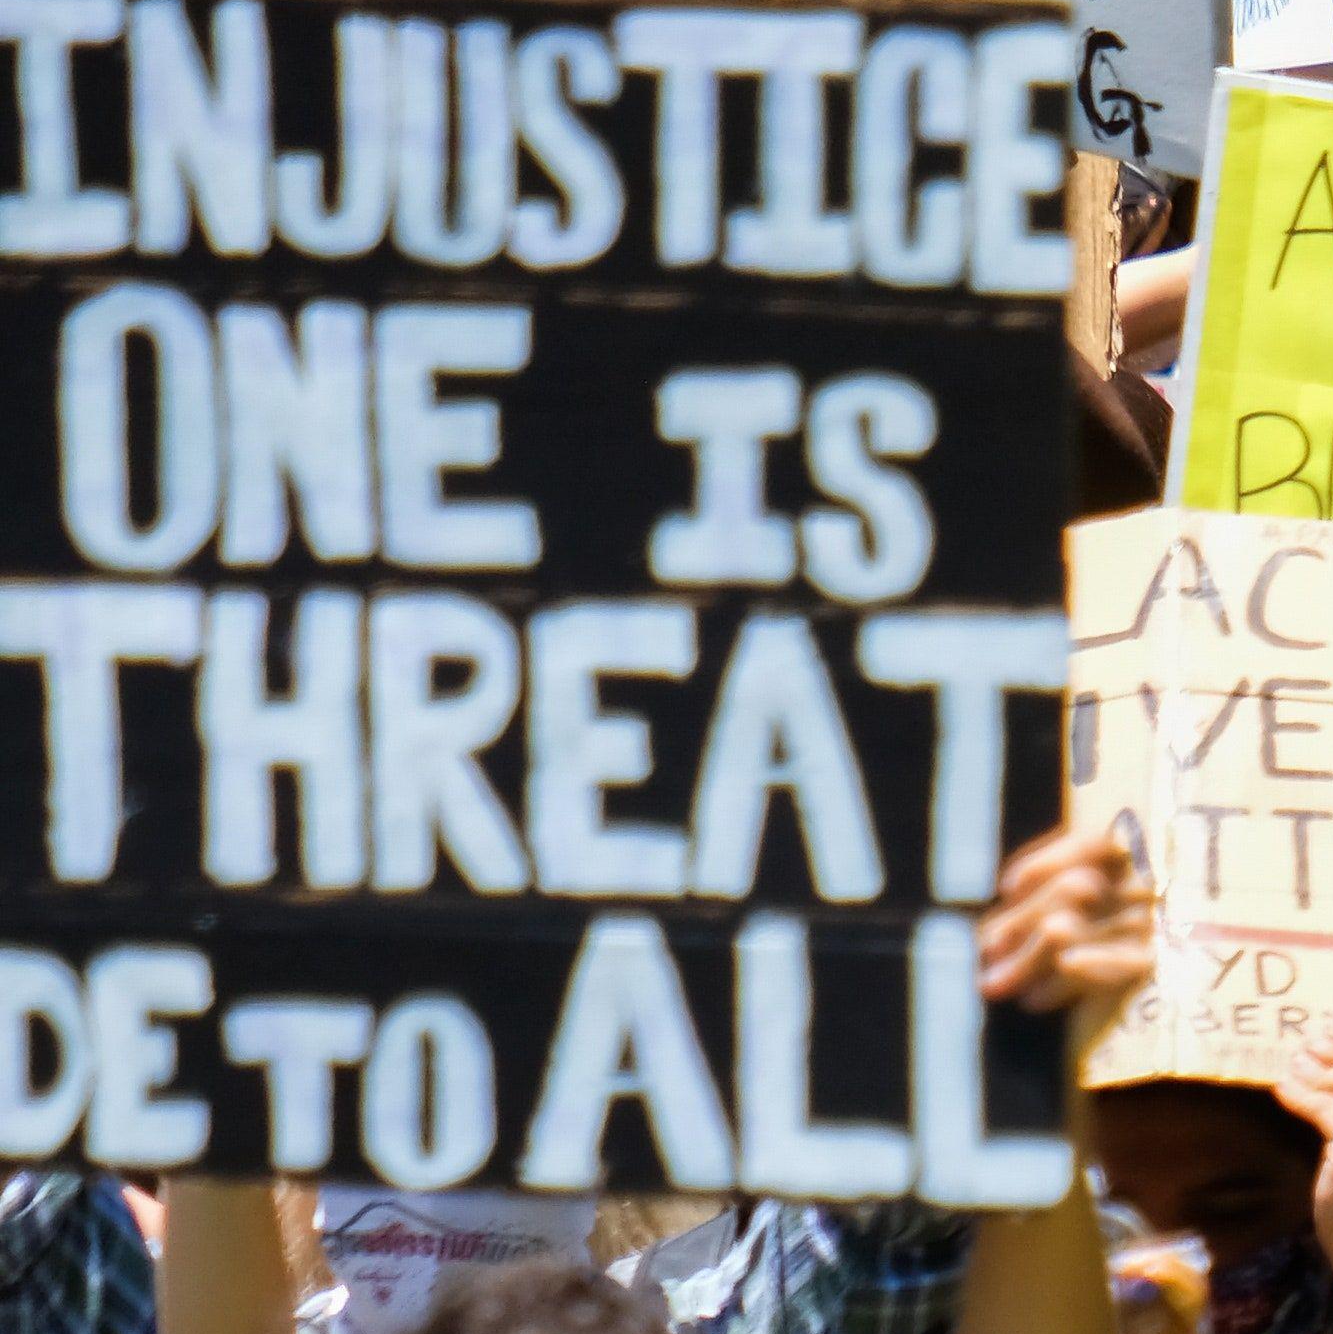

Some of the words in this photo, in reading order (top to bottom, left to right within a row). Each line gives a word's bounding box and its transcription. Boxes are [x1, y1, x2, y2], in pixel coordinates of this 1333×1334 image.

[57, 282, 544, 574] ONE
[646, 365, 940, 605] IS
[0, 581, 1072, 907] THREAT
[222, 991, 498, 1193] TO
[517, 910, 1076, 1211] ALL
